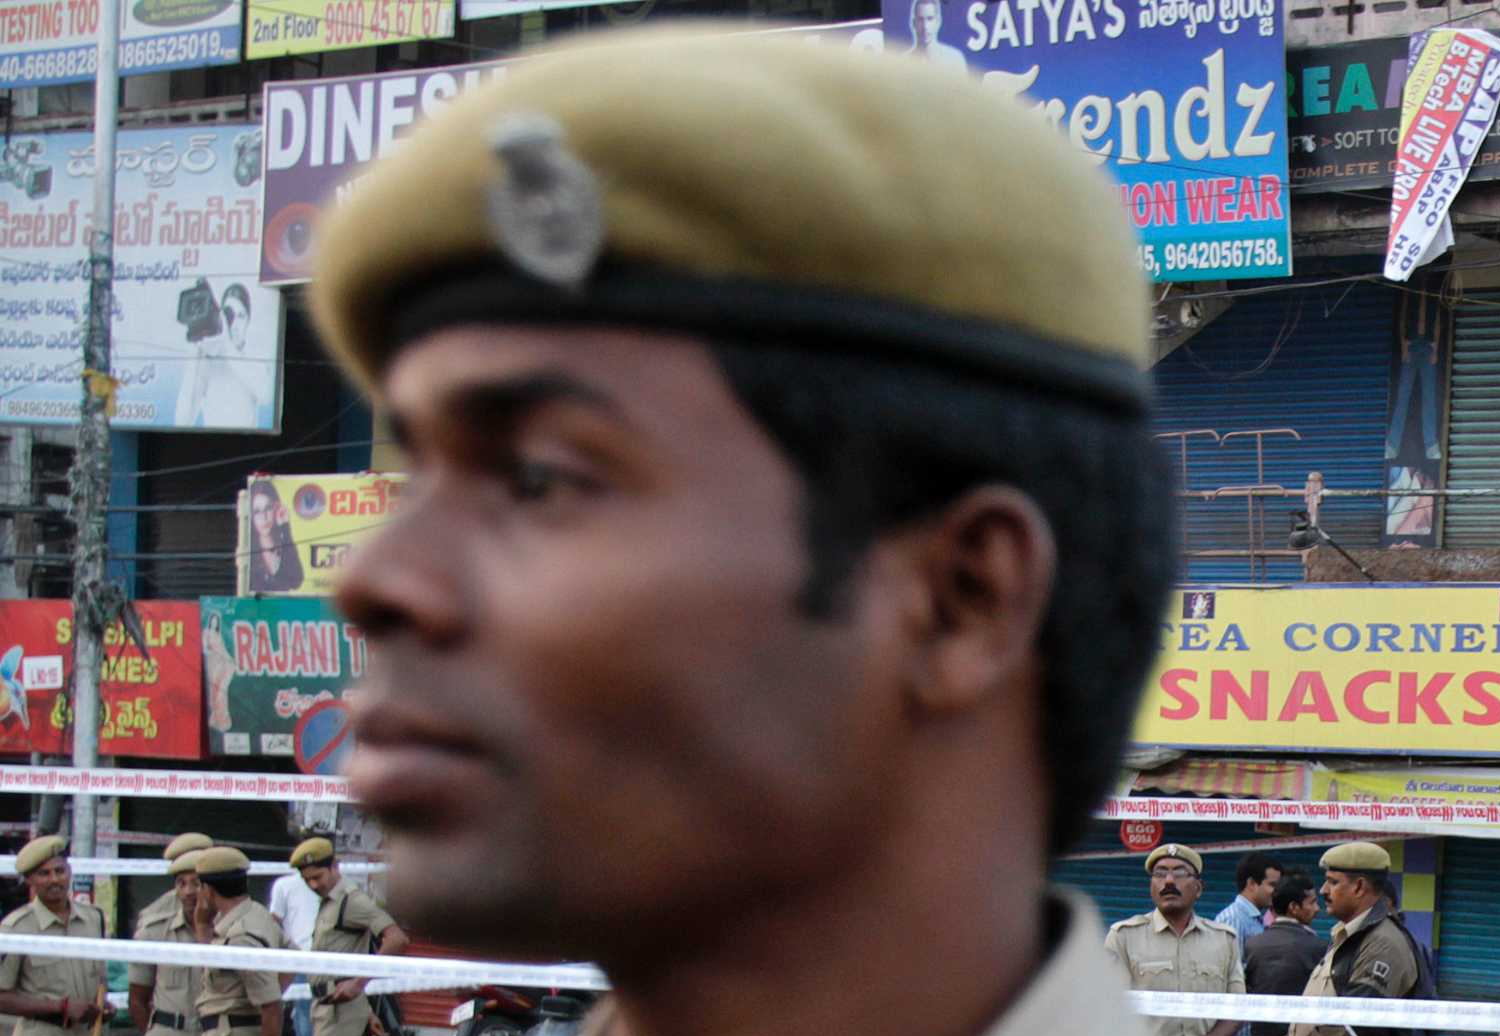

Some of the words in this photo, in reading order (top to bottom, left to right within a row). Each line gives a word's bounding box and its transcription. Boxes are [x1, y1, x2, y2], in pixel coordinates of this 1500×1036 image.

[254, 18, 279, 42] 2nd
[284, 13, 319, 39] Floor
[966, 0, 1126, 51] SATYA'S
[1445, 47, 1485, 112] MBA
[1334, 129, 1375, 150] SOFT
[1187, 175, 1283, 224] WEAR
[1417, 153, 1451, 215] ABAP
[1426, 174, 1459, 228] FICO
[1399, 242, 1421, 273] SD
[233, 619, 341, 677] RAJANI
